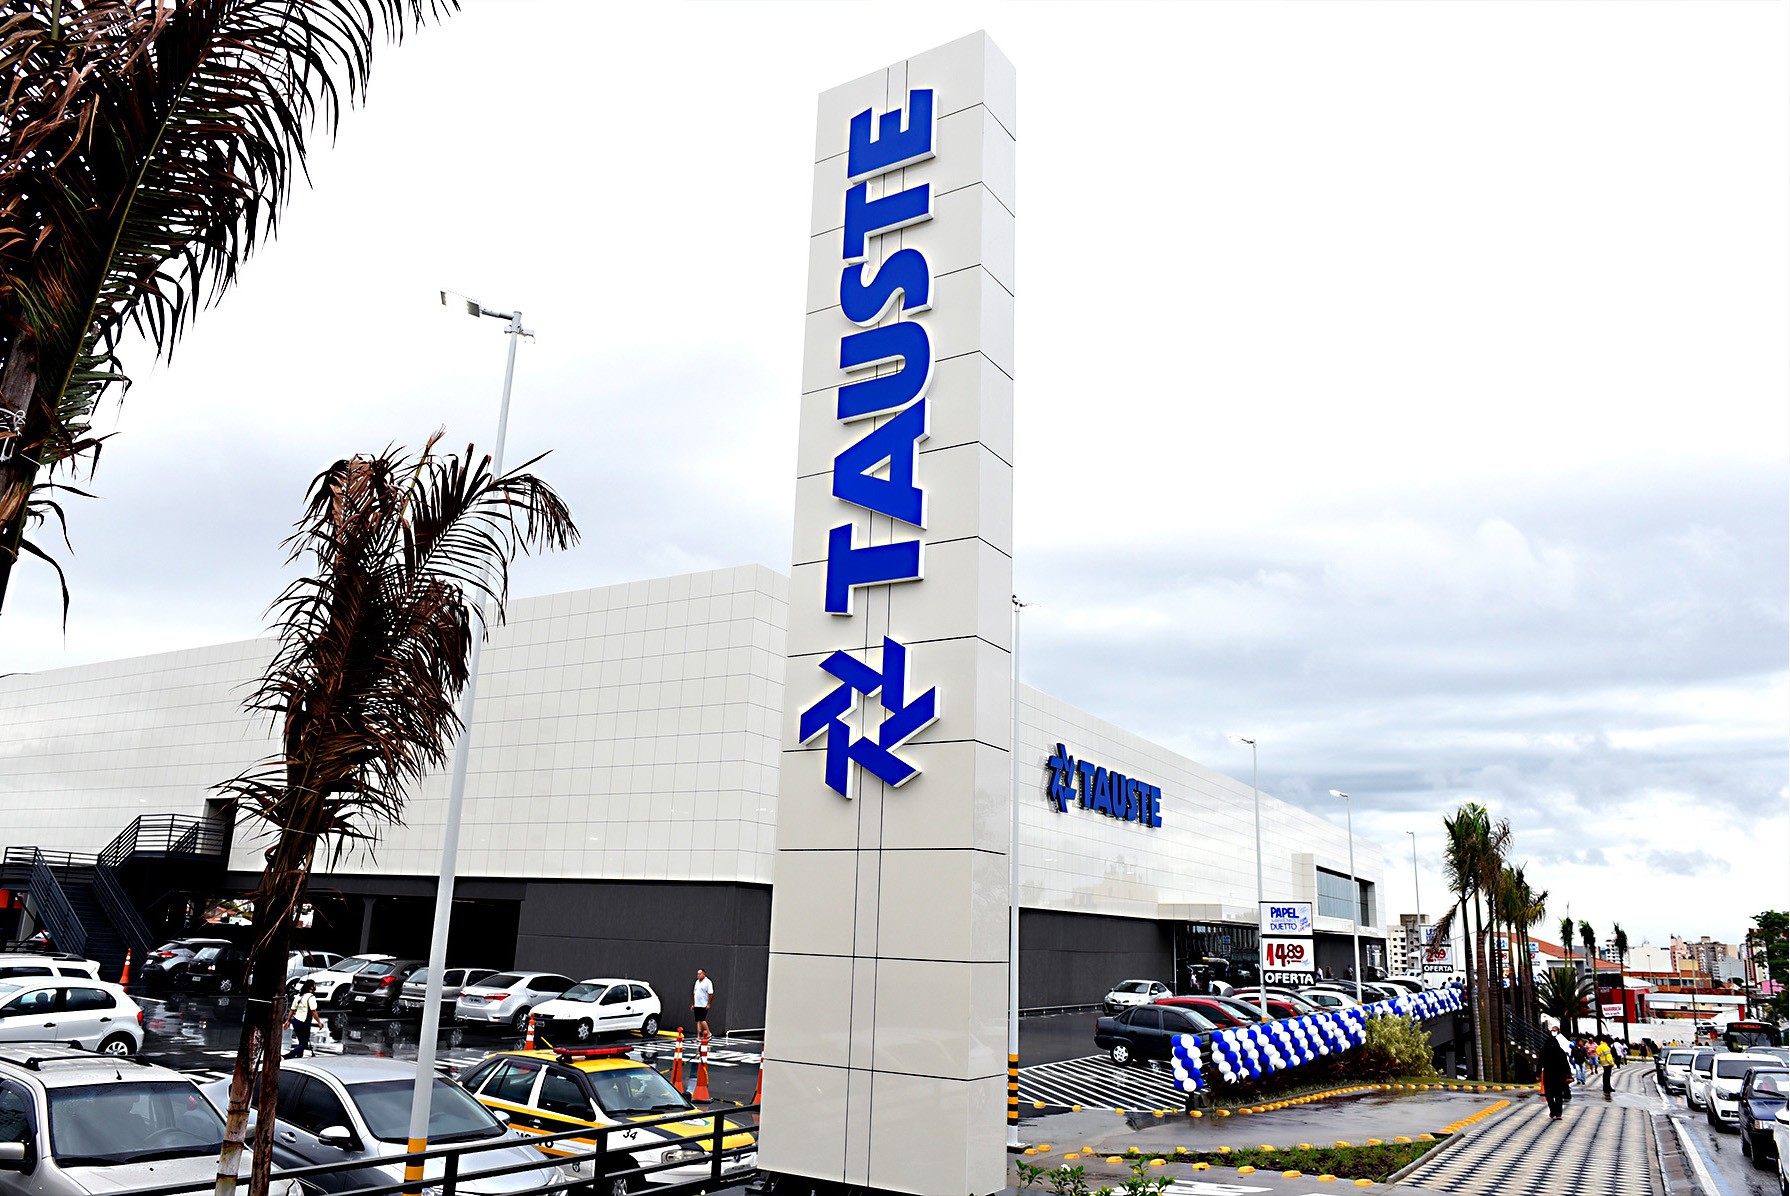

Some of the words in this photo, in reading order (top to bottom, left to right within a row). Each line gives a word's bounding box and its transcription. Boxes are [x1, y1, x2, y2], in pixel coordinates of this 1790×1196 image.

[825, 88, 936, 615] TAUSTE
[1077, 759, 1162, 828] TAUSTE
[1270, 906, 1299, 918] PAPEL
[1270, 922, 1297, 930] DUETTO
[1265, 972, 1314, 984] OFERTA
